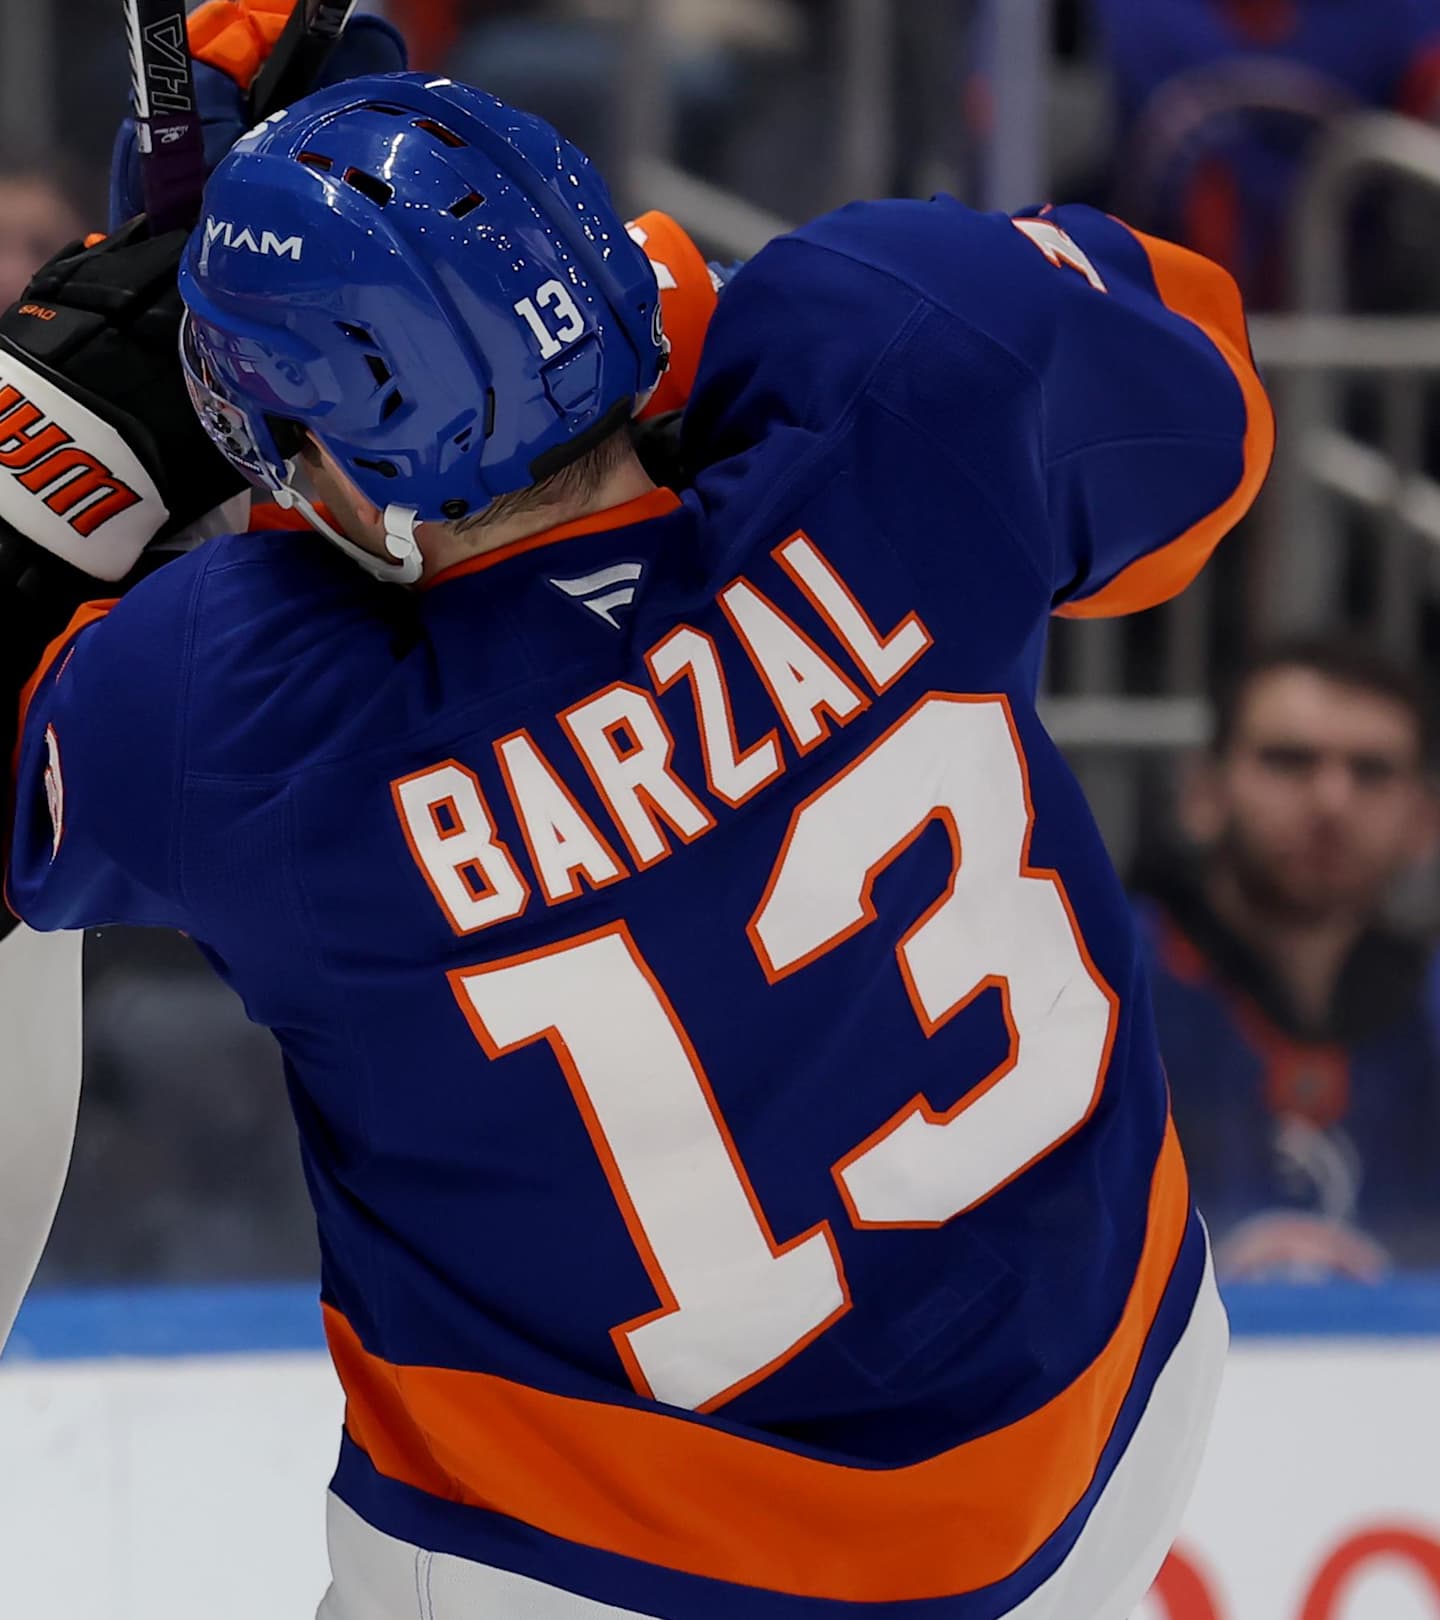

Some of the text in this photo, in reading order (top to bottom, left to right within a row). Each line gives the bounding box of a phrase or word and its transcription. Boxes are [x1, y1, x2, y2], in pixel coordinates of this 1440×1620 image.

[144, 13, 192, 117] HA
[206, 217, 303, 261] VIAM
[514, 279, 585, 360] 13
[390, 530, 934, 935] BARZAL
[447, 691, 1121, 1415] 13
